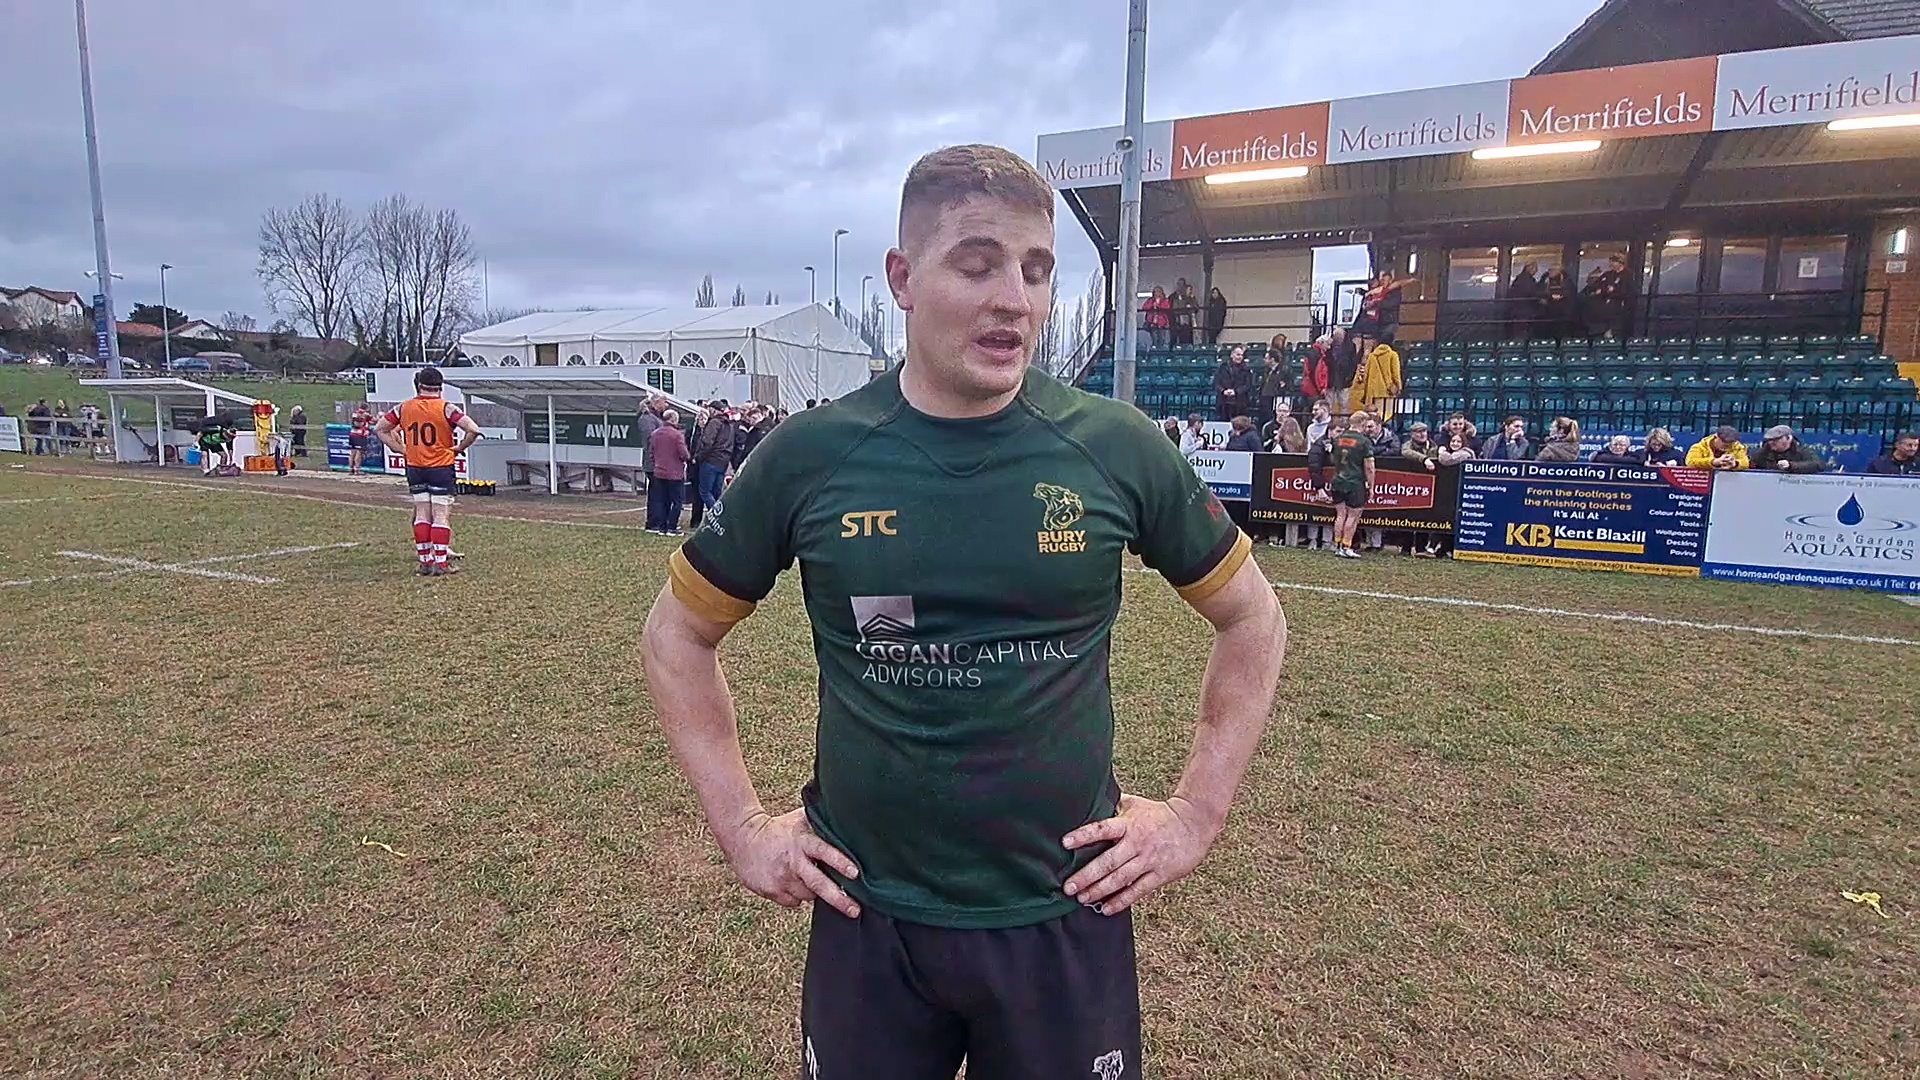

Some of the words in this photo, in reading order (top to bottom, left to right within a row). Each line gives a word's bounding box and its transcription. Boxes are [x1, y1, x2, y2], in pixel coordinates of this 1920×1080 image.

[1729, 70, 1919, 119] Merrifield
[1519, 91, 1702, 137] Merrifields
[1339, 111, 1497, 153] Merrifields
[1181, 132, 1319, 171] Merrifields
[1045, 148, 1163, 180] Merrifids
[407, 421, 436, 447] 10
[585, 423, 631, 439] AWAY
[1188, 456, 1225, 470] sbury
[1464, 463, 1518, 476] Building
[1528, 465, 1606, 480] Decorating
[1617, 468, 1658, 480] Glass
[1463, 484, 1507, 493] Landscaping
[1526, 487, 1553, 496] From
[1554, 488, 1572, 497] the
[1574, 489, 1618, 500] footings
[1620, 491, 1632, 500] to
[1376, 496, 1398, 505] Game
[1668, 493, 1704, 501] Designer
[1524, 498, 1541, 507] the
[1543, 499, 1587, 510] finishing
[1588, 501, 1632, 511] touches
[1678, 500, 1703, 508] Paints
[1252, 510, 1277, 519] 01284
[1279, 511, 1308, 521] 768351
[1312, 515, 1452, 530] www.undsbutchers.co.uk
[1553, 510, 1569, 518] It's
[1570, 511, 1585, 519] All
[1586, 511, 1600, 520] At
[1674, 510, 1702, 519] Mixing
[841, 510, 897, 538] STC
[1460, 520, 1493, 528] Insulation
[1037, 530, 1086, 543] BURY
[1460, 529, 1487, 537] Fencing
[1505, 522, 1552, 548] KB
[1554, 525, 1594, 539] Kent
[1596, 527, 1647, 543] Blaxill
[1655, 528, 1699, 537] Wallpapers
[1784, 530, 1826, 542] Home
[1835, 533, 1845, 543] &
[1855, 534, 1914, 547] Garden
[1038, 542, 1087, 553] RUGBY
[1459, 537, 1485, 546] Roofing
[1666, 539, 1698, 548] Decking
[1669, 549, 1697, 558] Paving
[1783, 542, 1914, 561] AQUATICS
[861, 662, 982, 688] ADVISORS
